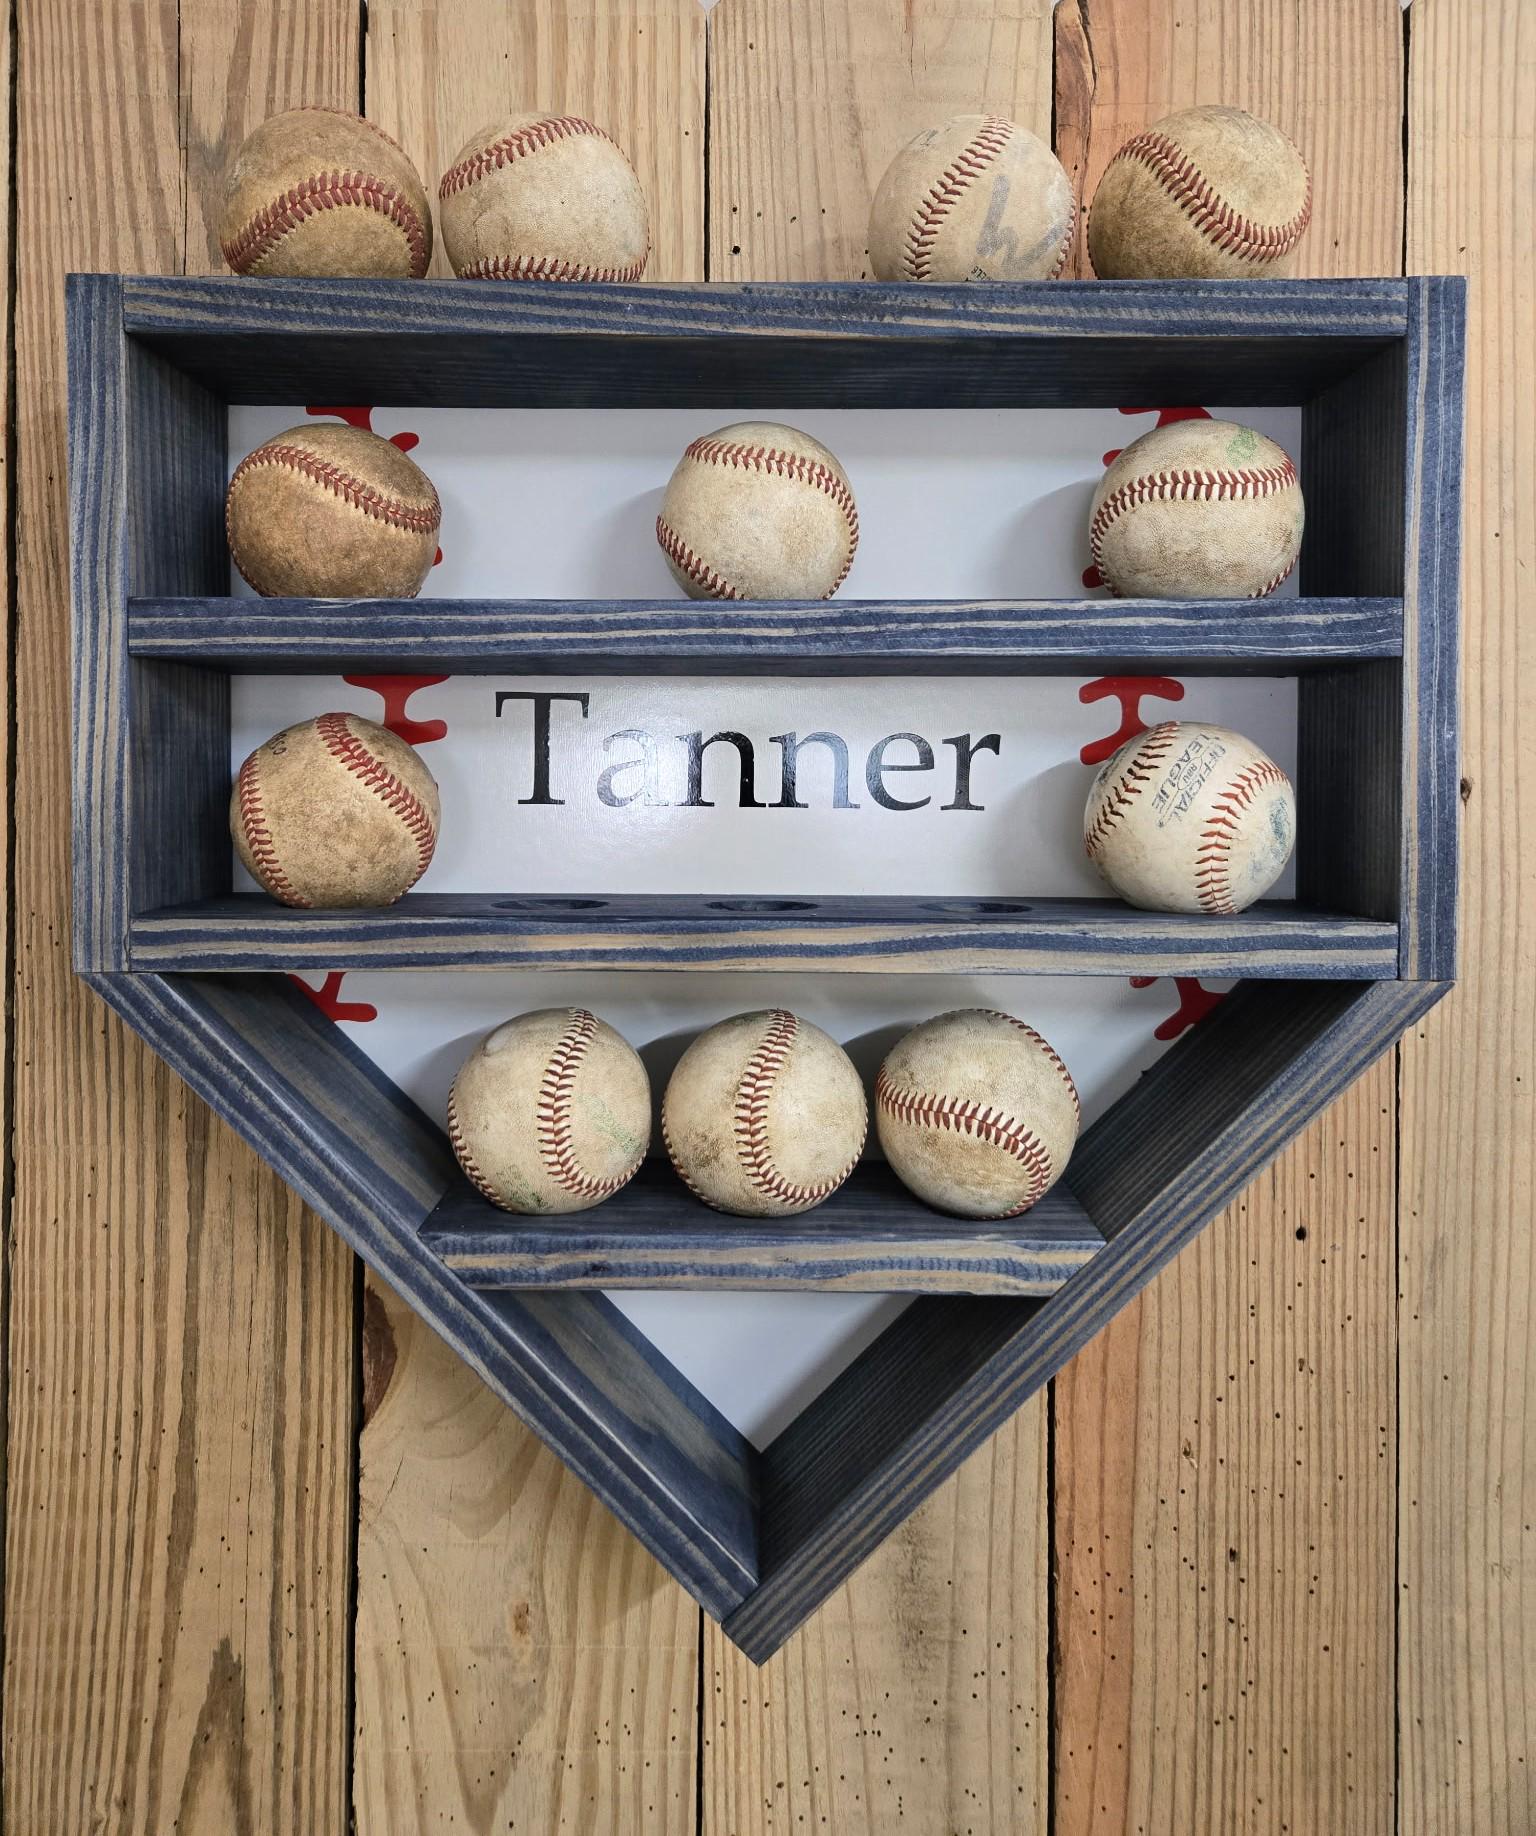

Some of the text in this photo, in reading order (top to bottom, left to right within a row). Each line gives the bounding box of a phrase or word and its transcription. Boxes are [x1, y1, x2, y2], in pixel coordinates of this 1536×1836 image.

[494, 691, 1001, 810] Tanner
[1151, 733, 1210, 814] LEAGUE
[1168, 743, 1227, 822] OFFICIAL
